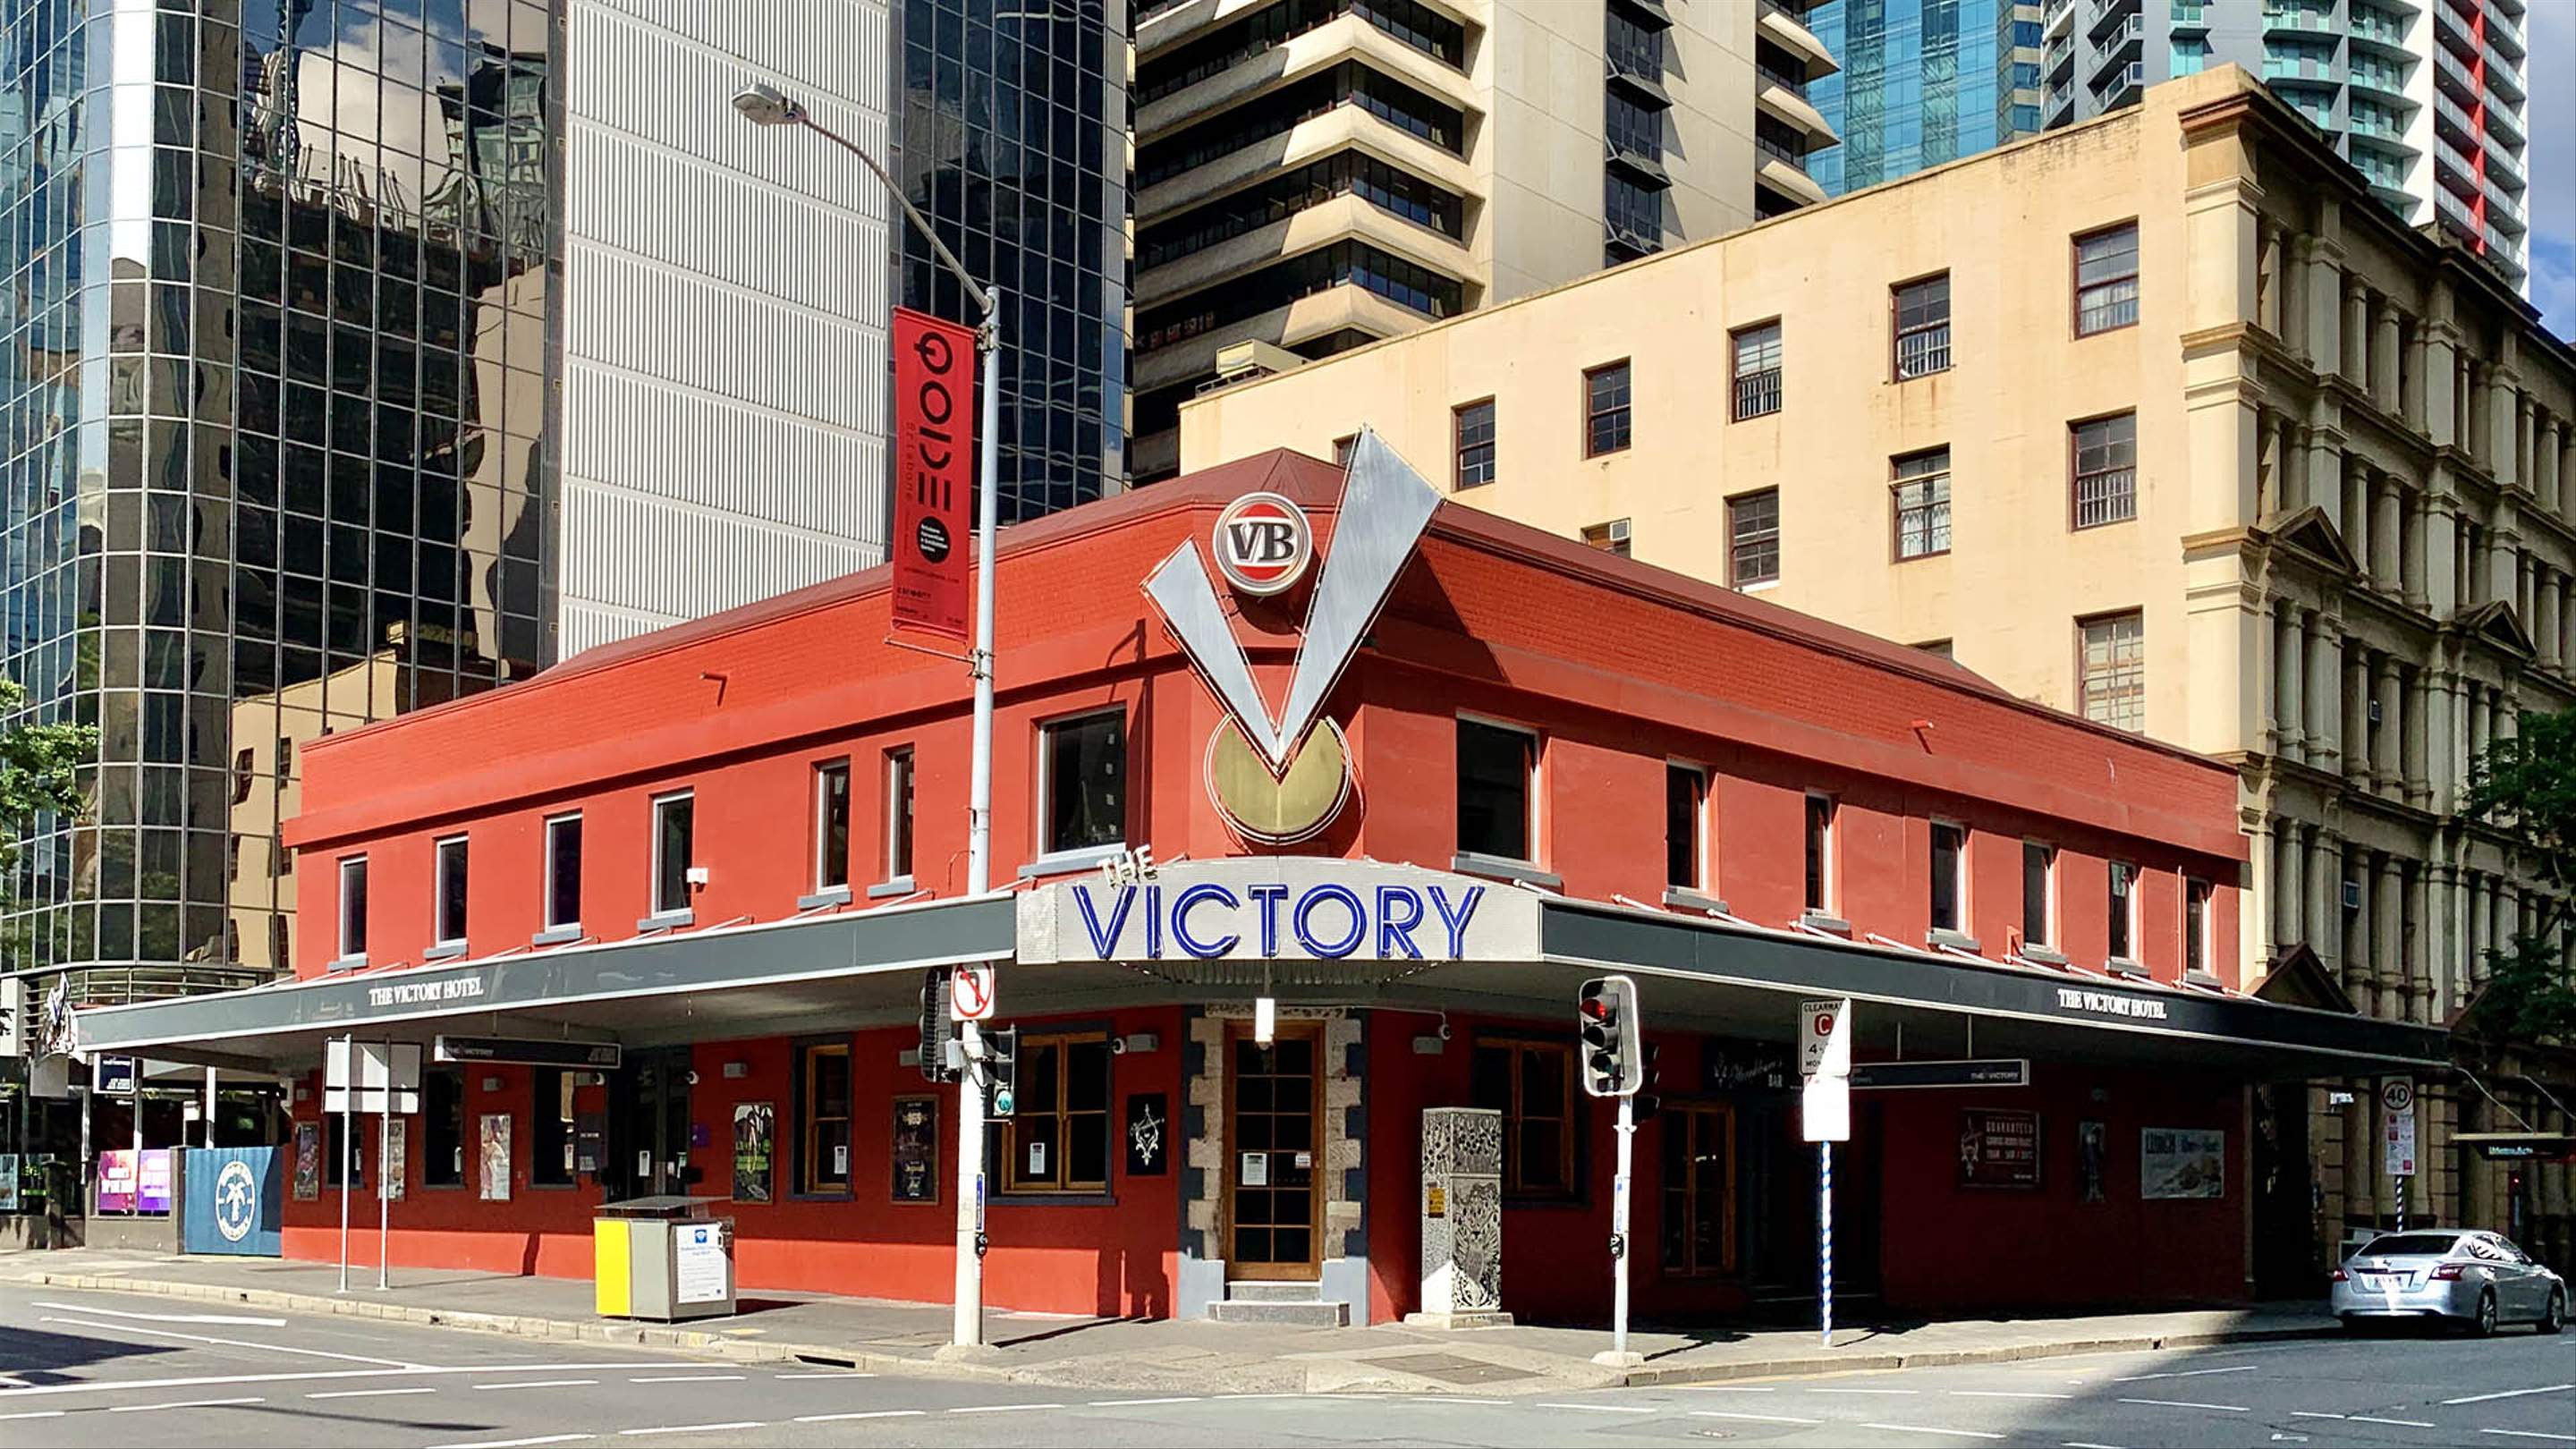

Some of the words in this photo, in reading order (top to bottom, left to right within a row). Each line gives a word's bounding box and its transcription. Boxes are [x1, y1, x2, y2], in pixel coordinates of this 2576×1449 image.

[1228, 521, 1294, 562] VB
[1096, 844, 1157, 887] THE
[1072, 883, 1486, 960] VICTORY
[369, 987, 393, 1006] THE
[394, 982, 443, 1004] VICTORY
[444, 977, 484, 998] HOTEL
[2058, 988, 2082, 1009] THE
[2082, 992, 2131, 1015] VICTORY
[2131, 999, 2167, 1019] HOTEL
[2386, 1088, 2408, 1103] 40
